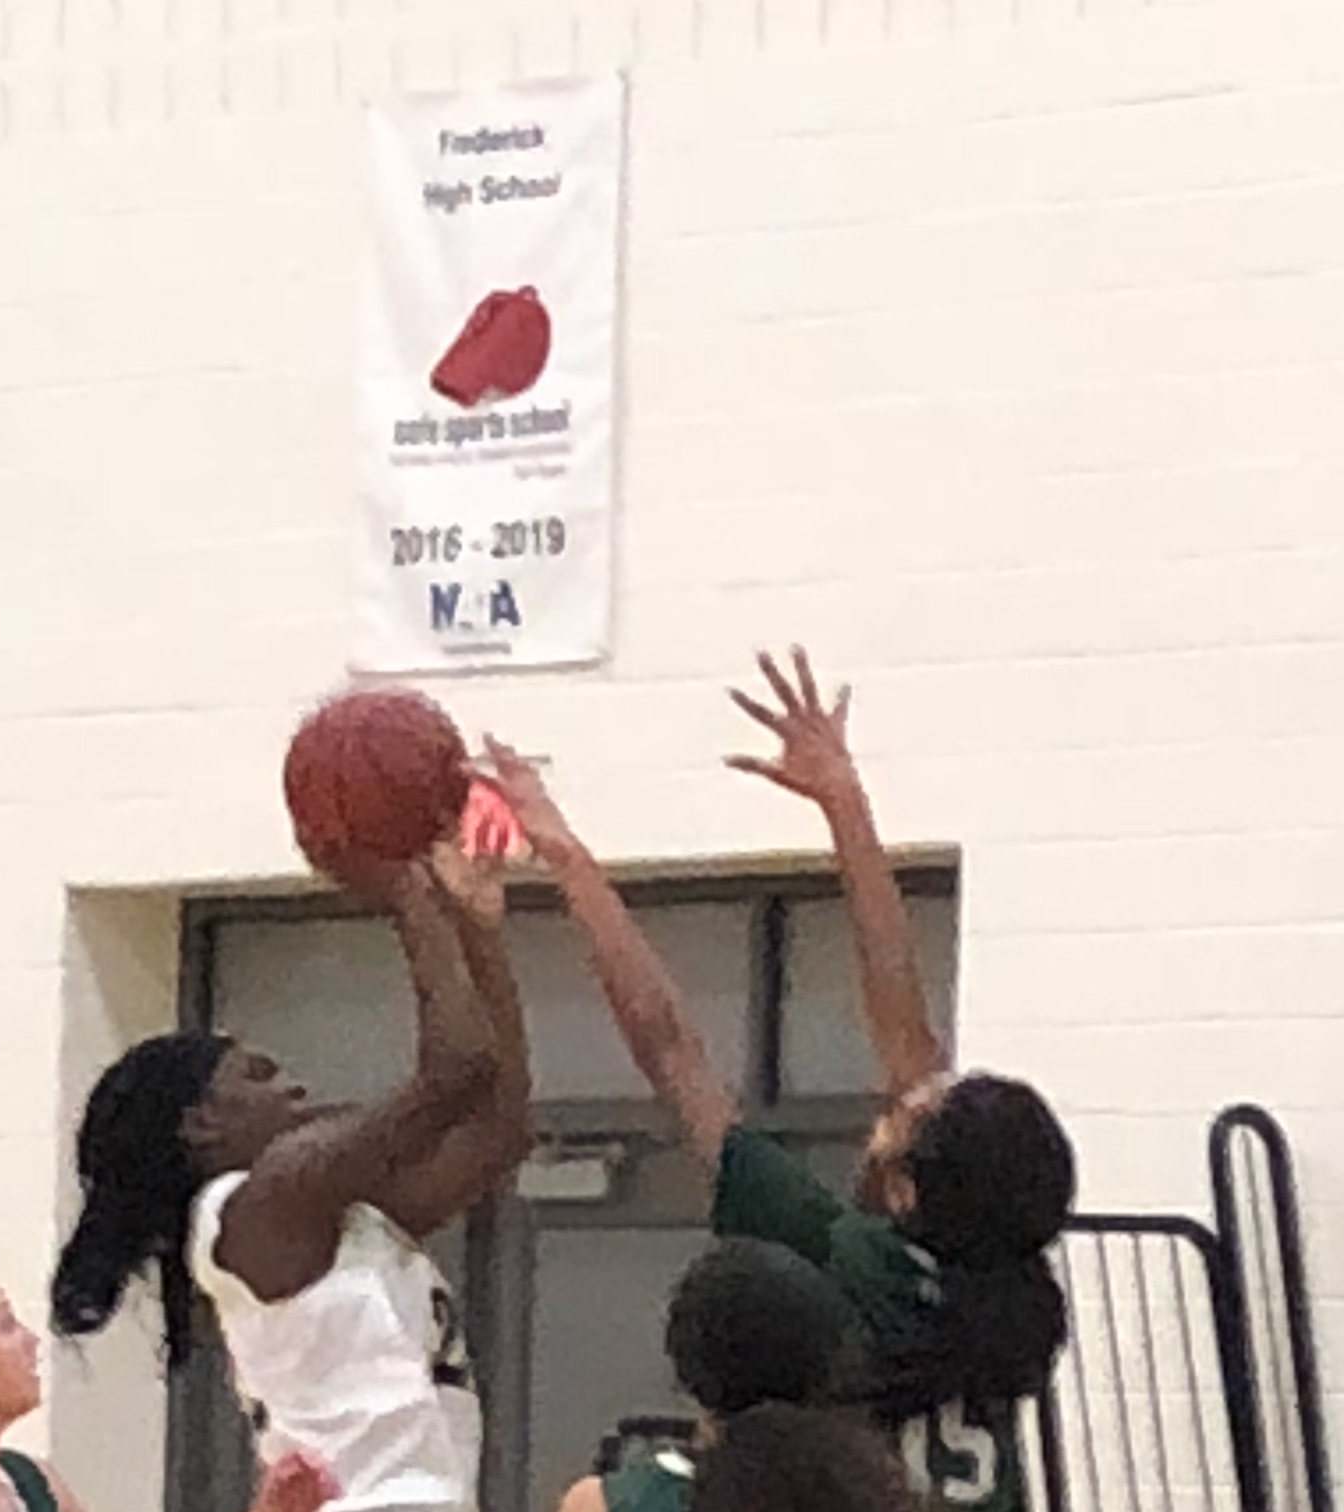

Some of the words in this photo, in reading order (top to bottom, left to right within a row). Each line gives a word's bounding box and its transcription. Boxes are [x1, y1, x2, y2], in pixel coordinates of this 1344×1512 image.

[440, 125, 545, 156] Frederick
[422, 180, 473, 215] High
[479, 172, 562, 205] School
[444, 411, 505, 449] sports
[511, 399, 572, 437] school
[390, 522, 463, 566] 2016
[490, 515, 566, 559] 2019
[901, 1396, 997, 1502] 15
